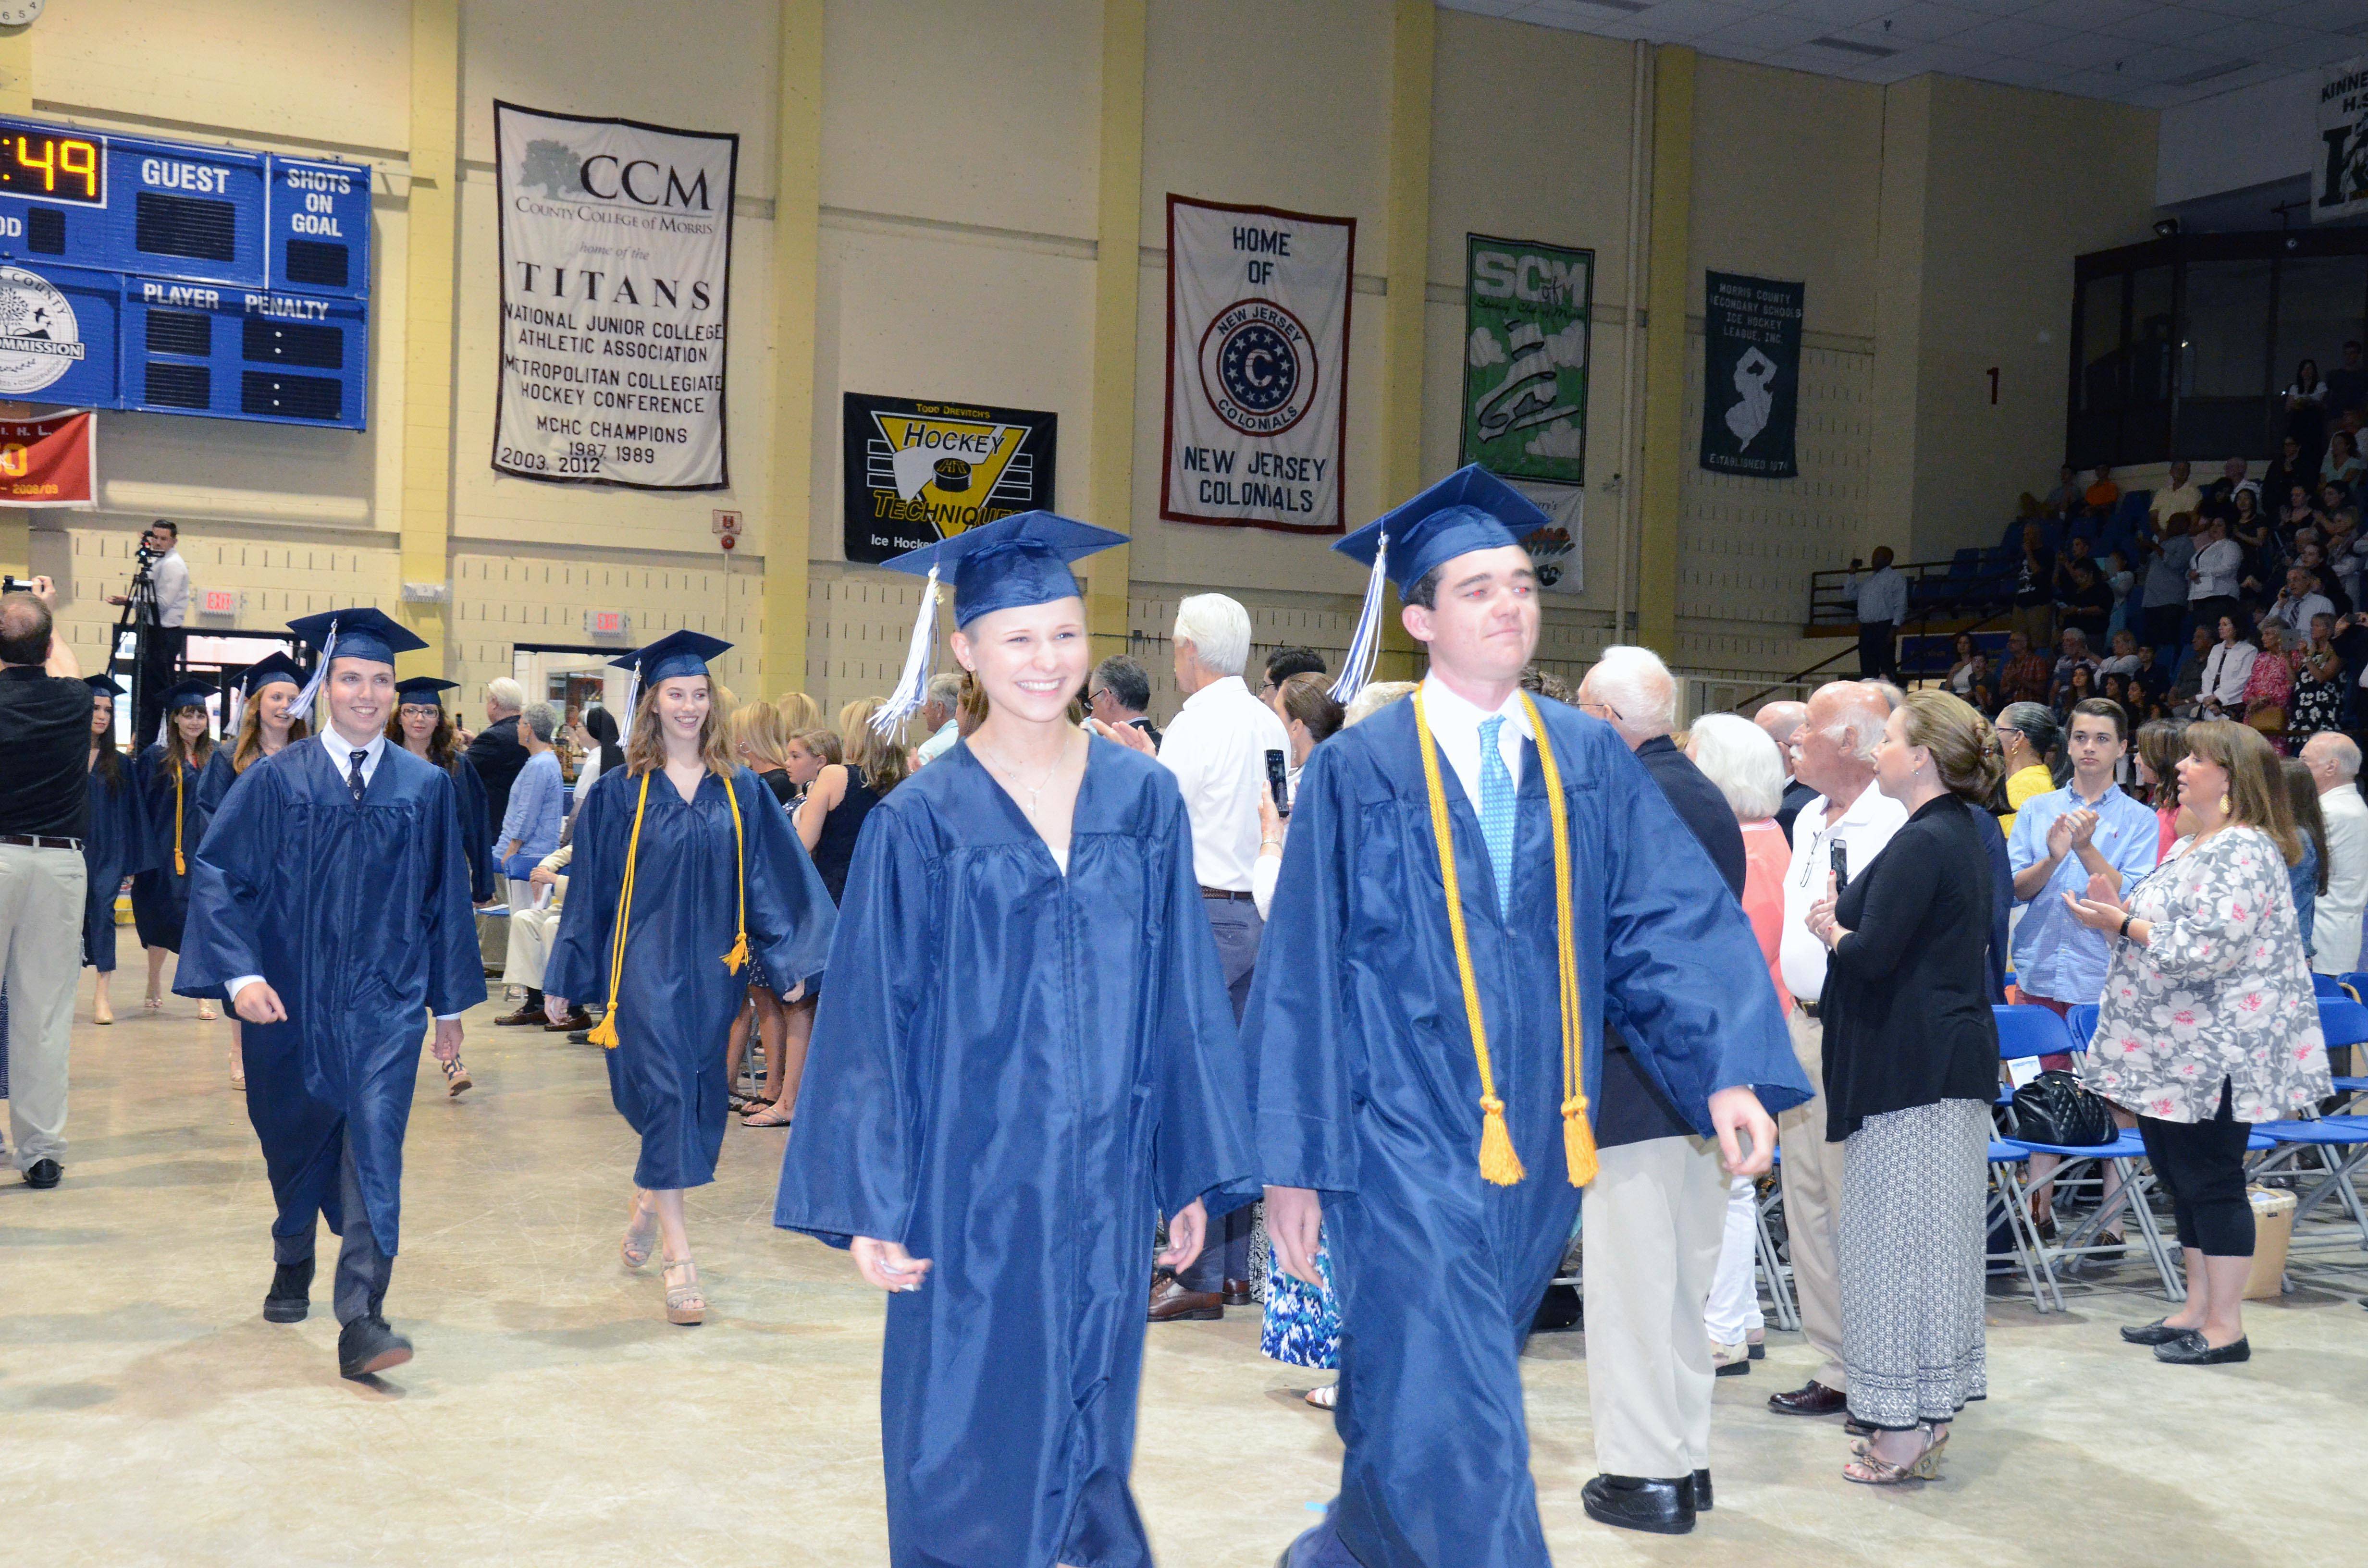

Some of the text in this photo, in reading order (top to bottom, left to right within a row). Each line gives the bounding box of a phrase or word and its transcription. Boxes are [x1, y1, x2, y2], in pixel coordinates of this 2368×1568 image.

[142, 159, 230, 194] GUEST
[288, 170, 351, 194] SHOTS
[580, 155, 714, 210] CCM
[306, 193, 333, 214] ON
[516, 196, 712, 234] COUNTY COLLEGE of MORRIS
[292, 214, 343, 237] GOAL
[1233, 226, 1291, 257] HOME
[517, 261, 710, 311] TITANS
[1248, 260, 1274, 284] OF
[12, 273, 67, 314] COUNTY
[144, 283, 219, 309] PLAYER
[244, 294, 329, 320] PENALTY
[1719, 282, 1791, 304] MORRIS COUNTY
[505, 302, 723, 341] NATIONAL JUNIOR COLLEGE
[1217, 306, 1303, 342] NEW JERSEY
[1727, 312, 1782, 331] ICE HOCKEY
[0, 338, 81, 356] MMISSION
[519, 329, 707, 362] ATHLETIC ASSOCIATION
[505, 354, 722, 392] METROPOLITAN COLLEGIATE
[1987, 367, 1999, 404] 1
[521, 382, 704, 413] HOCKEY CONFERENCE
[916, 404, 990, 418] TODD DREVITCH'S
[1219, 399, 1298, 430] COLONIALS
[537, 416, 688, 443] MCHC CHAMPIONS
[902, 422, 1006, 457] HOCKEY
[559, 457, 600, 473] 2012
[617, 446, 654, 464] 1989
[1184, 446, 1326, 481] NEW JERSEY
[1199, 479, 1313, 513] COLONIALS
[871, 534, 888, 546] Ice
[206, 591, 231, 611] EXIT
[597, 612, 619, 631] EXIT
